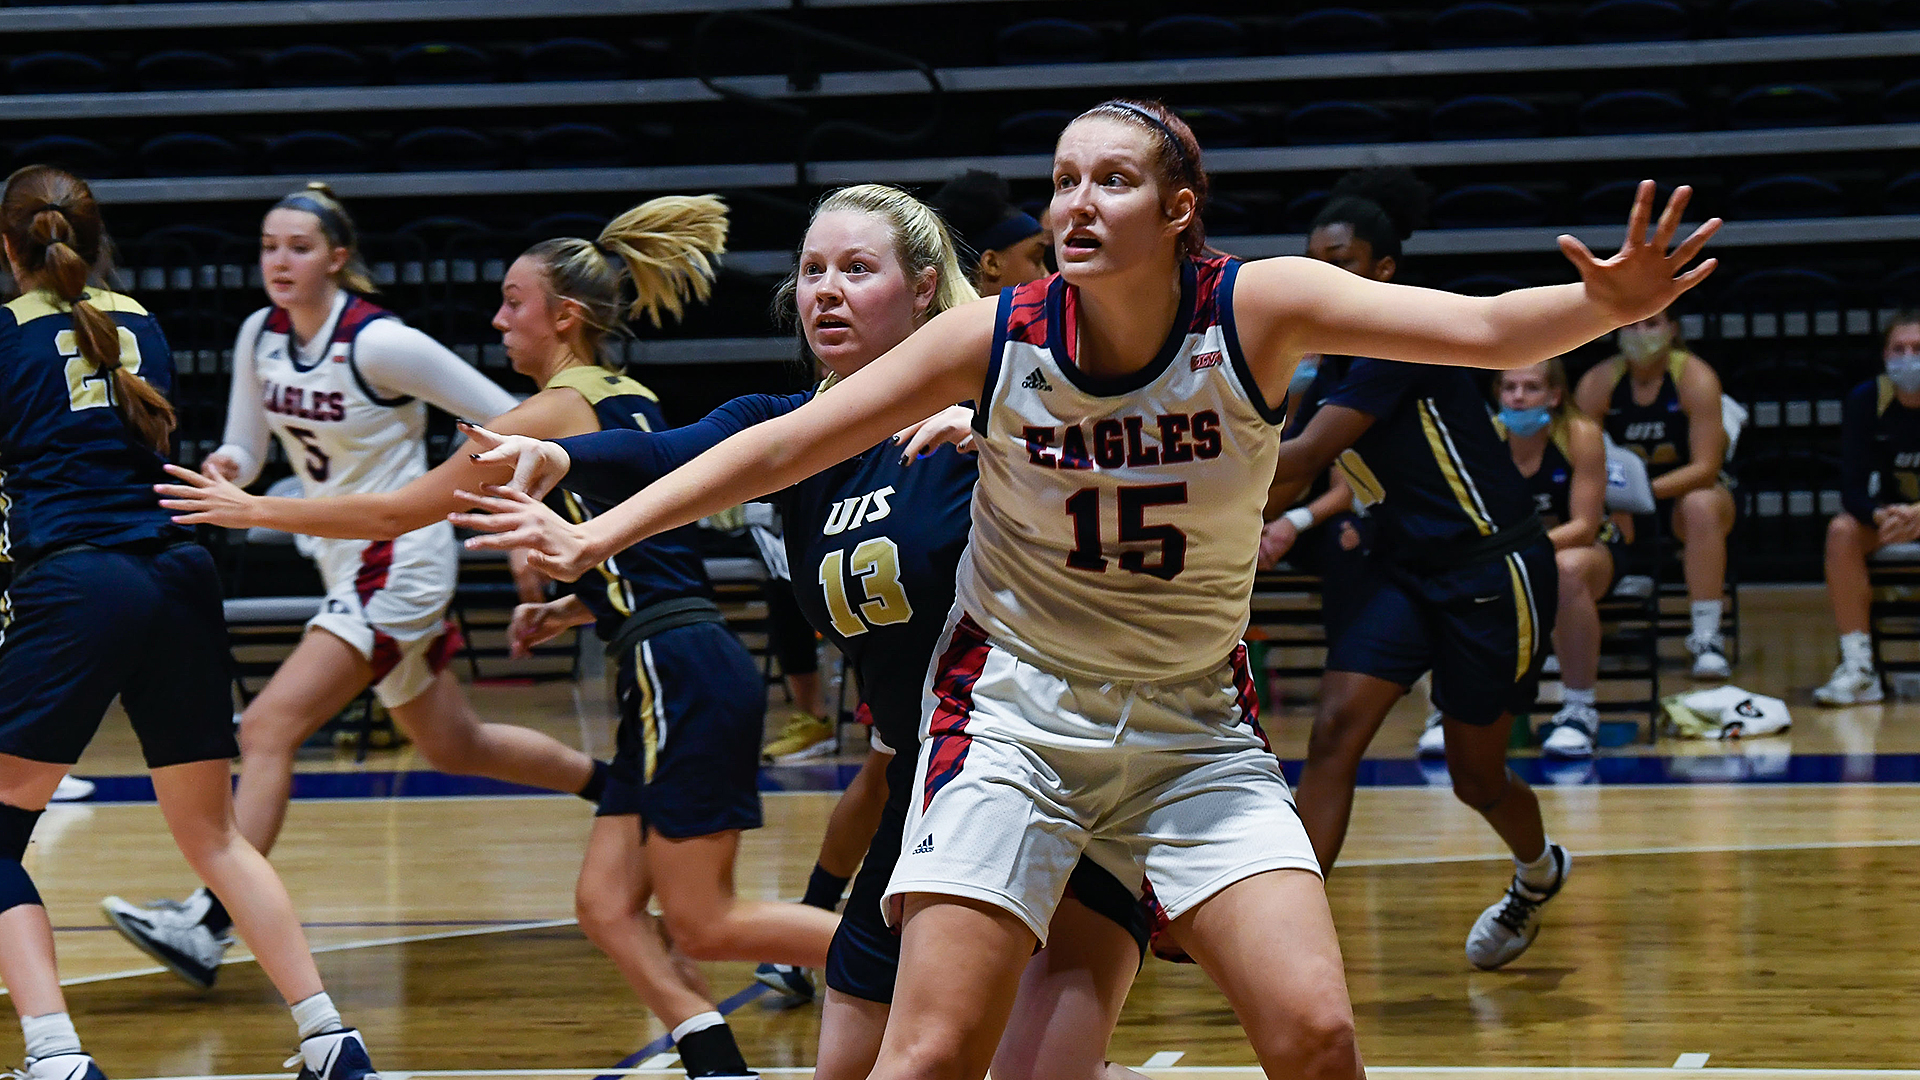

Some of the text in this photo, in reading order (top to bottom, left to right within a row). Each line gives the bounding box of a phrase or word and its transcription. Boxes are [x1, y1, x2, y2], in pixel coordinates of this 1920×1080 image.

[1021, 379, 1053, 392] adidas
[284, 424, 331, 483] 5
[1022, 409, 1223, 470] EAGLES
[823, 485, 896, 536] UIS
[1065, 482, 1188, 581] 15
[818, 536, 914, 638] 13
[912, 845, 935, 855] adidas
